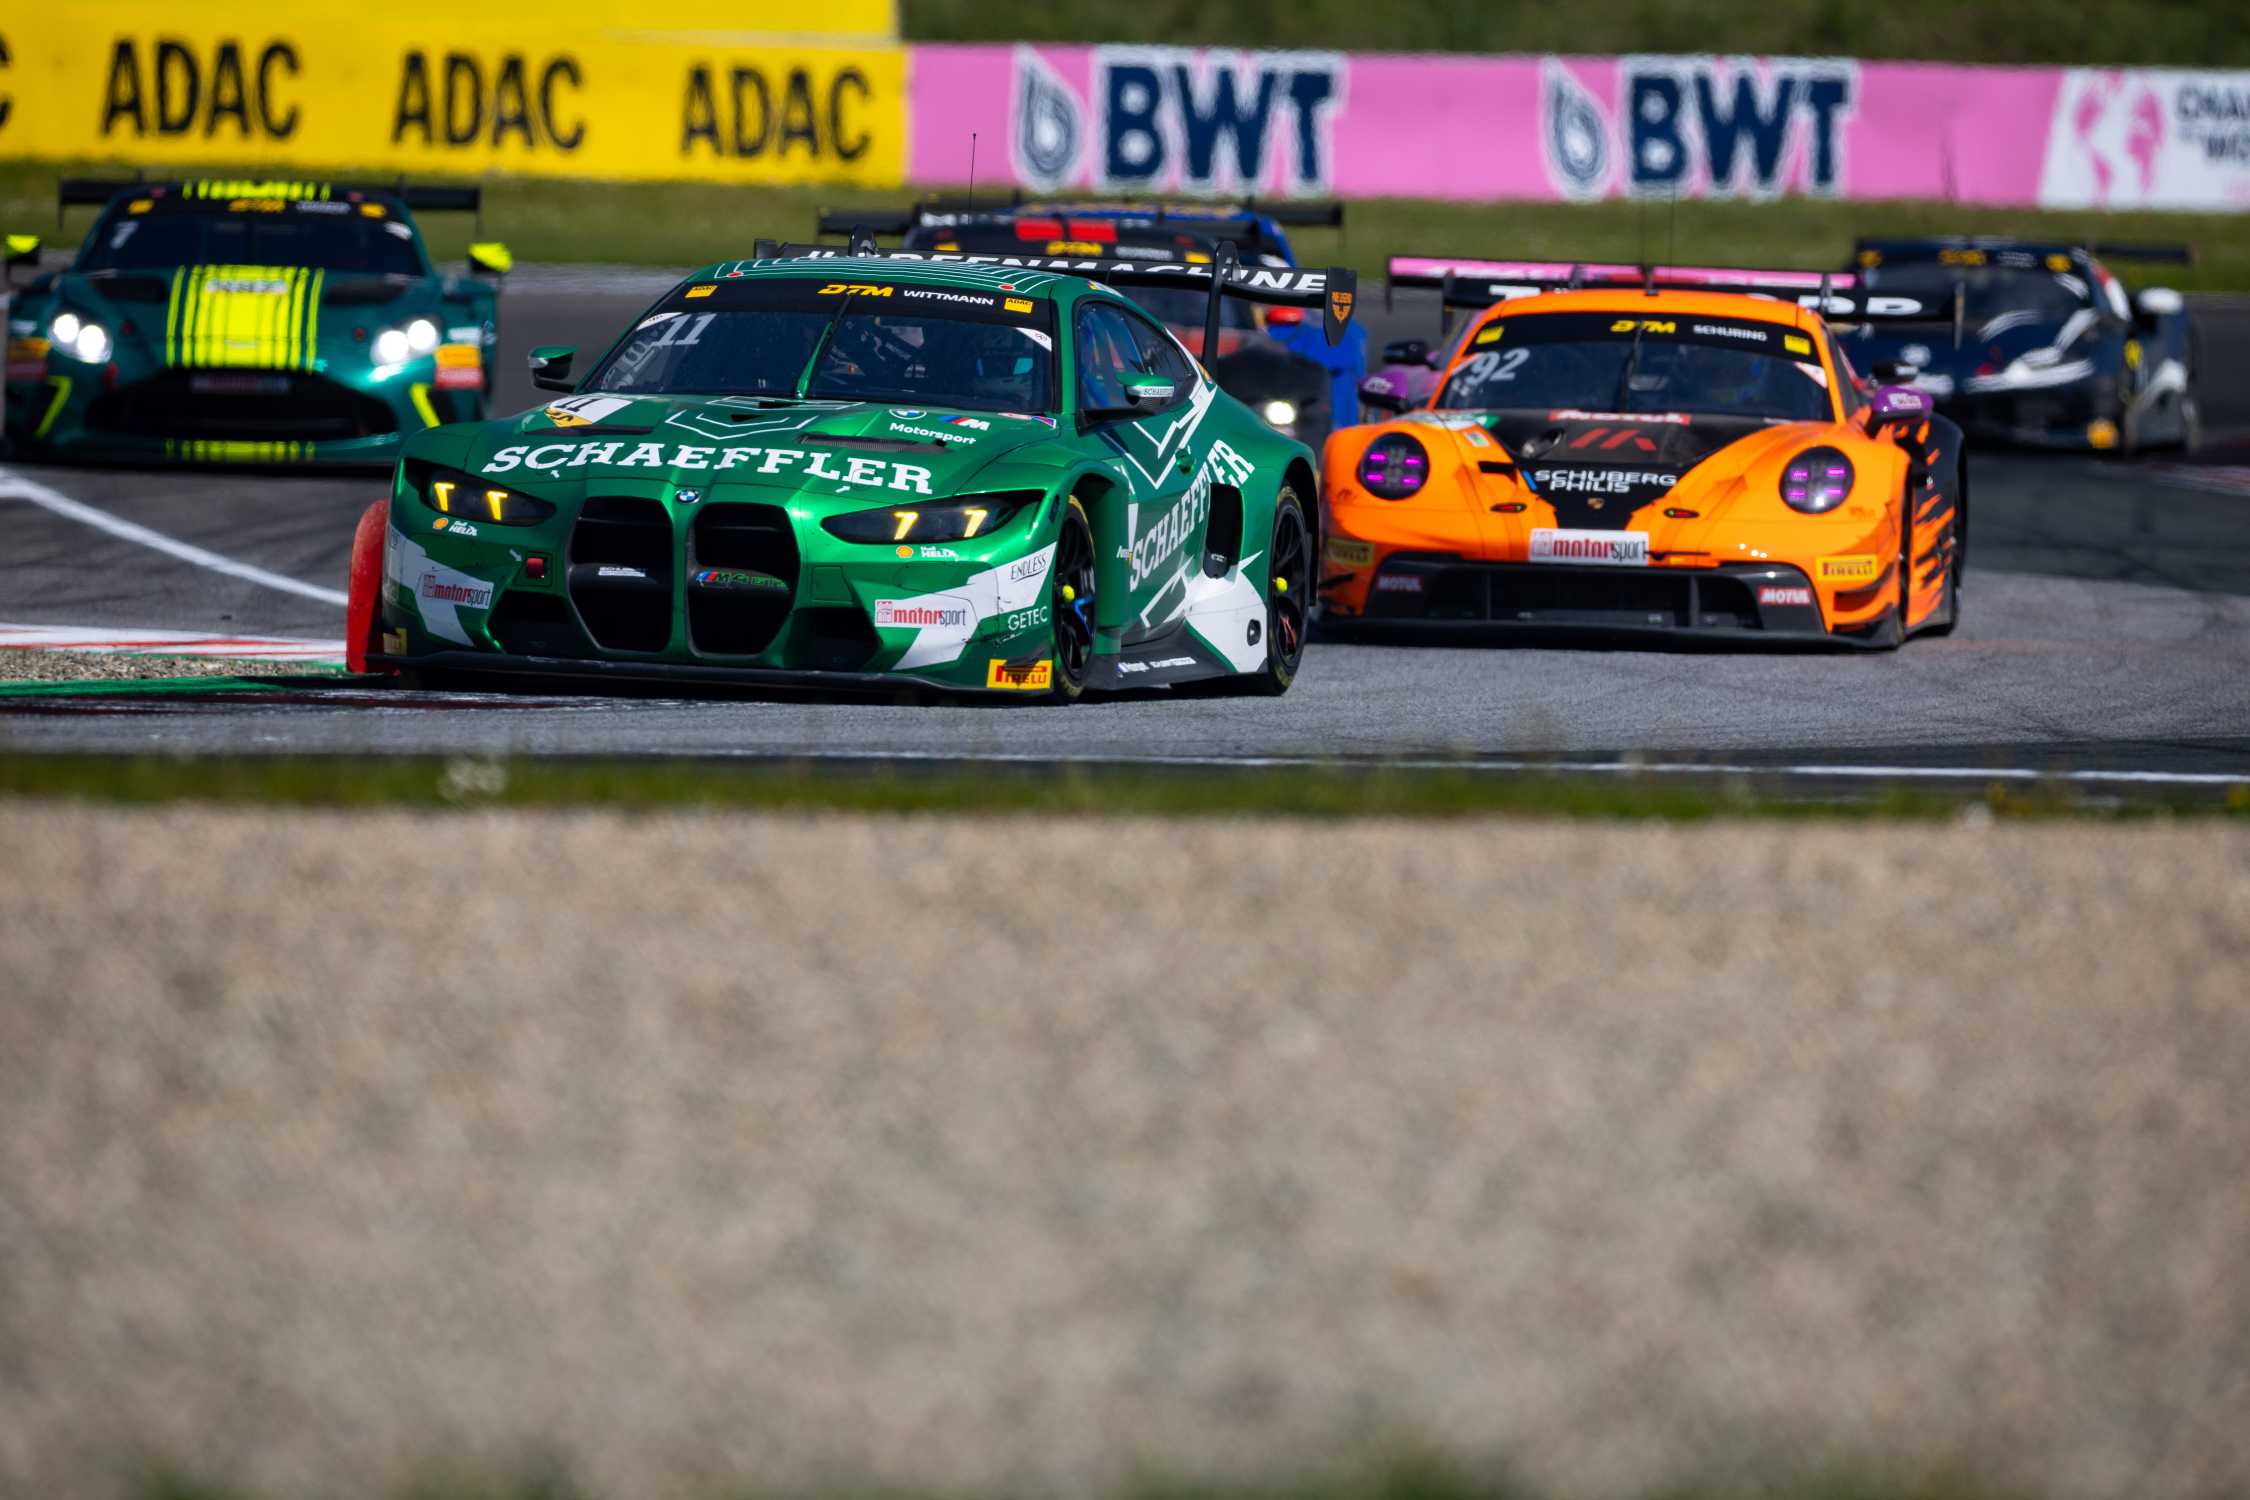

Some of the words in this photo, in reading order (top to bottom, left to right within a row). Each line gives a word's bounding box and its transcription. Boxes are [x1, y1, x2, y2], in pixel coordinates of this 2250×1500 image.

[101, 38, 301, 138] ADAC
[391, 50, 586, 150] ADAC
[680, 62, 872, 161] ADAC
[1108, 65, 1332, 181] BWT
[1631, 72, 1845, 183] BWT
[817, 284, 894, 297] DTM
[903, 289, 994, 306] WITTMANN
[652, 313, 717, 347] 11
[1610, 319, 1676, 334] DTM
[1693, 323, 1767, 342] SCHURING
[1465, 348, 1530, 385] 92
[890, 422, 976, 445] Motorsport
[481, 442, 933, 495] SCHAEFFLER
[1535, 470, 1677, 487] SCHUBERG
[1550, 480, 1630, 494] PHILIS
[1130, 439, 1255, 592] SCHAEFFER
[1553, 538, 1646, 561] motorsport
[1010, 553, 1047, 581] ENDLESS
[434, 583, 491, 607] motorsport
[1379, 575, 1422, 591] MOTUL
[1761, 588, 1811, 604] MOTUL
[893, 607, 966, 627] motorsport
[1007, 606, 1048, 630] GETEC
[996, 665, 1047, 684] PIRELLI
